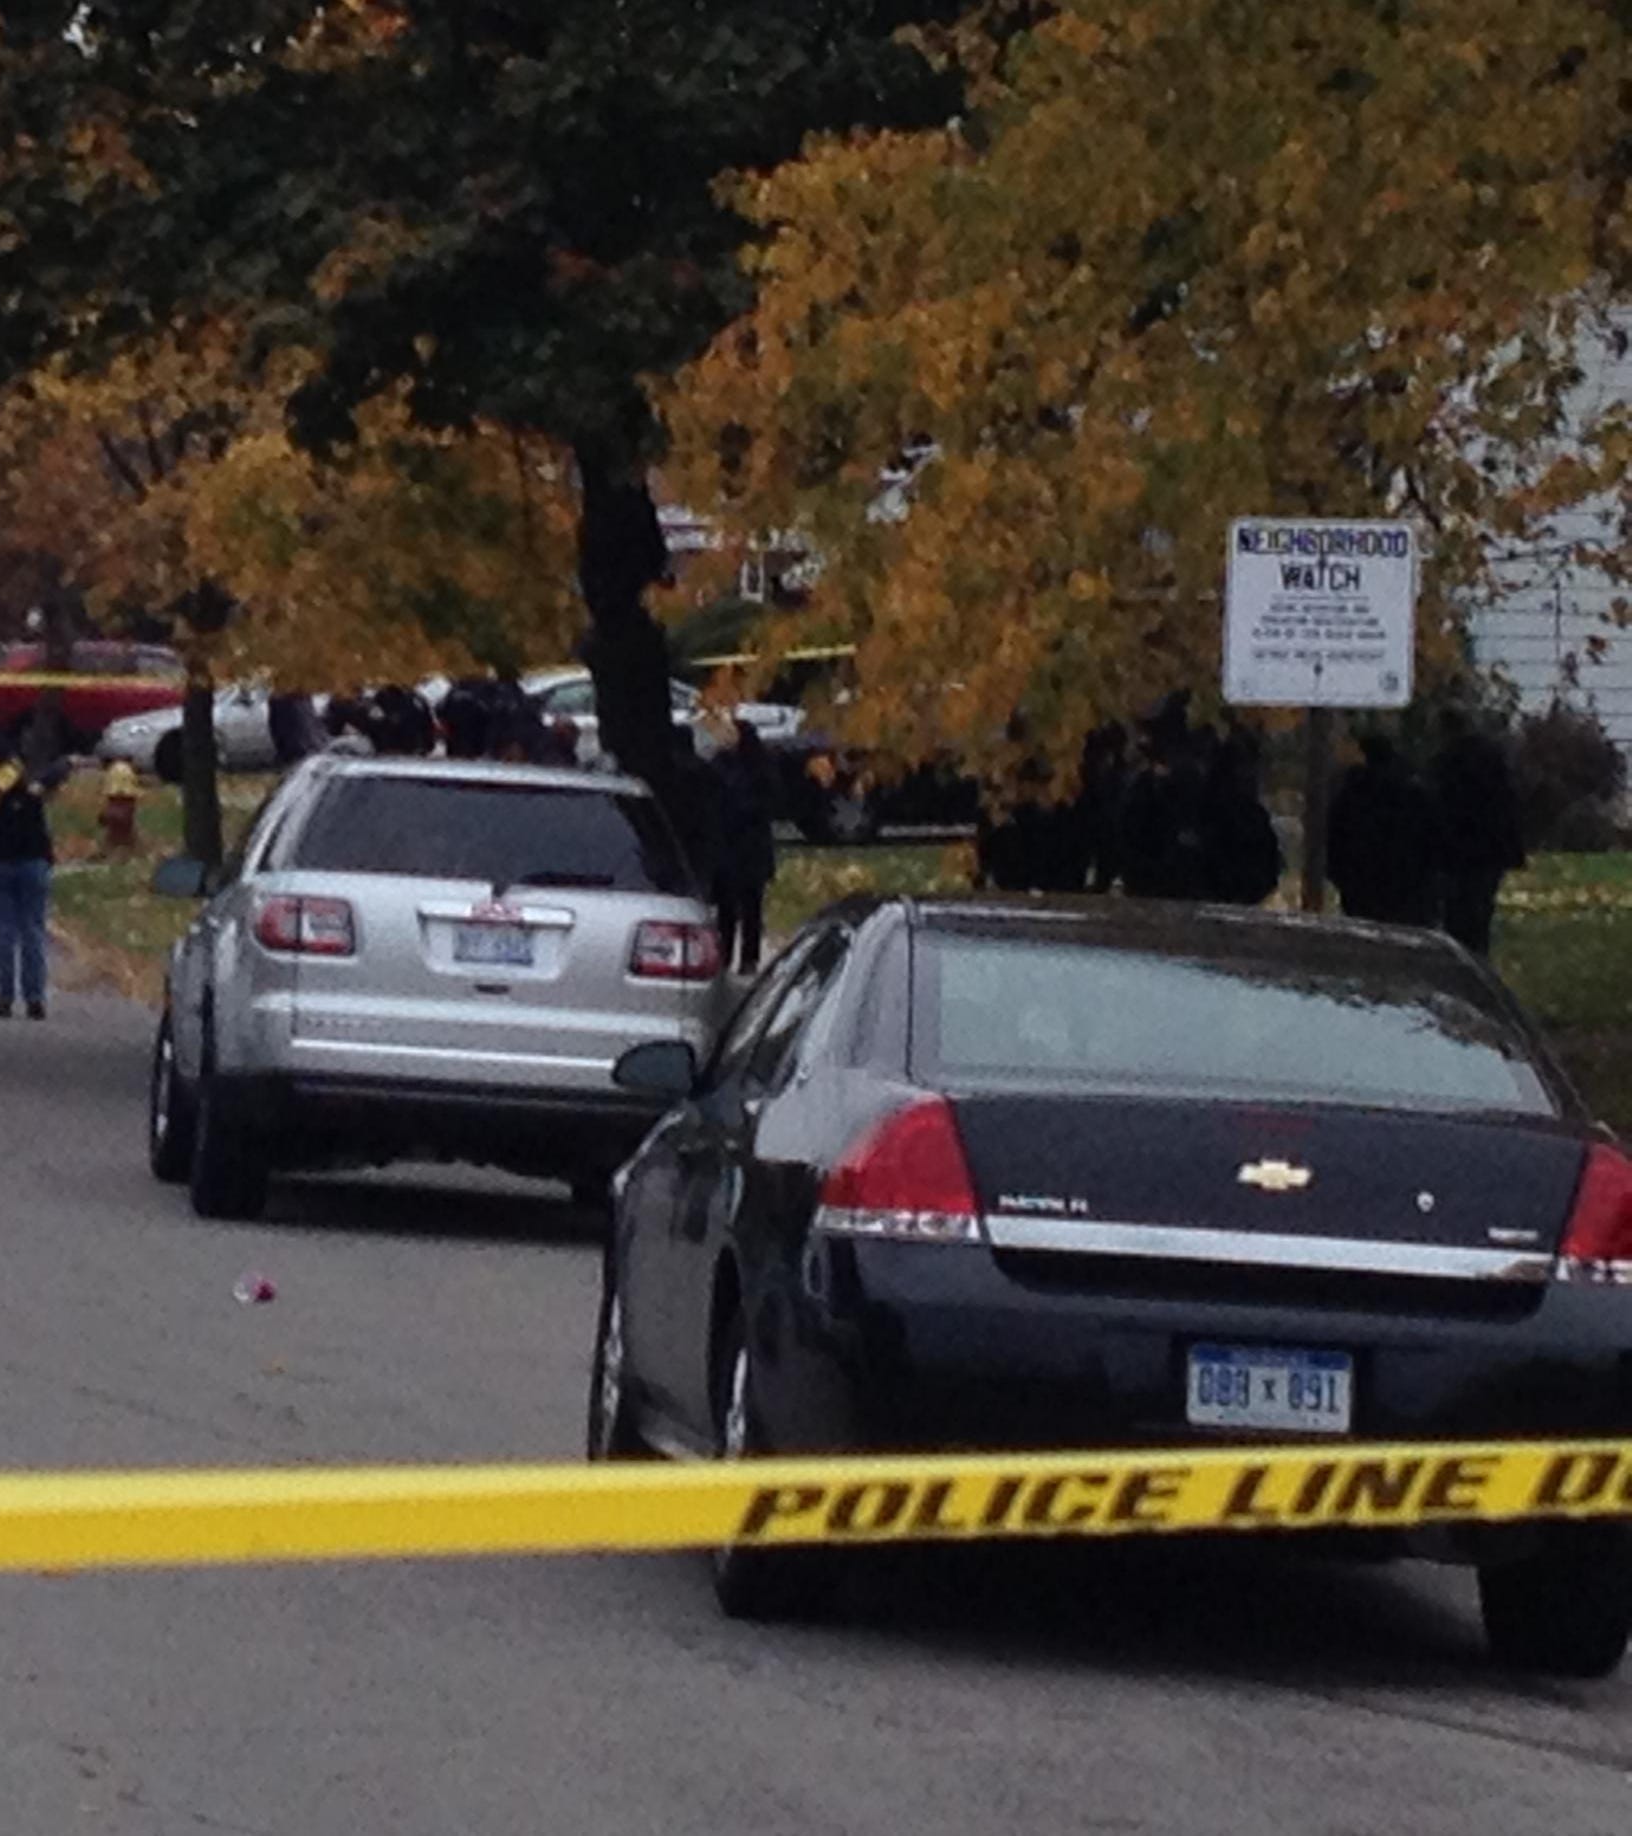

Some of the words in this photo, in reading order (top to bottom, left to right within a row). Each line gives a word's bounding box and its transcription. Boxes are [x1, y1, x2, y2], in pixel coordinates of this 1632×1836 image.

[1237, 528, 1408, 557] NEIGHBORHOOD
[1280, 563, 1361, 591] WATCH
[738, 1468, 1192, 1534] POLICE
[1223, 1455, 1502, 1514] LINE
[1534, 1452, 1632, 1505] D
